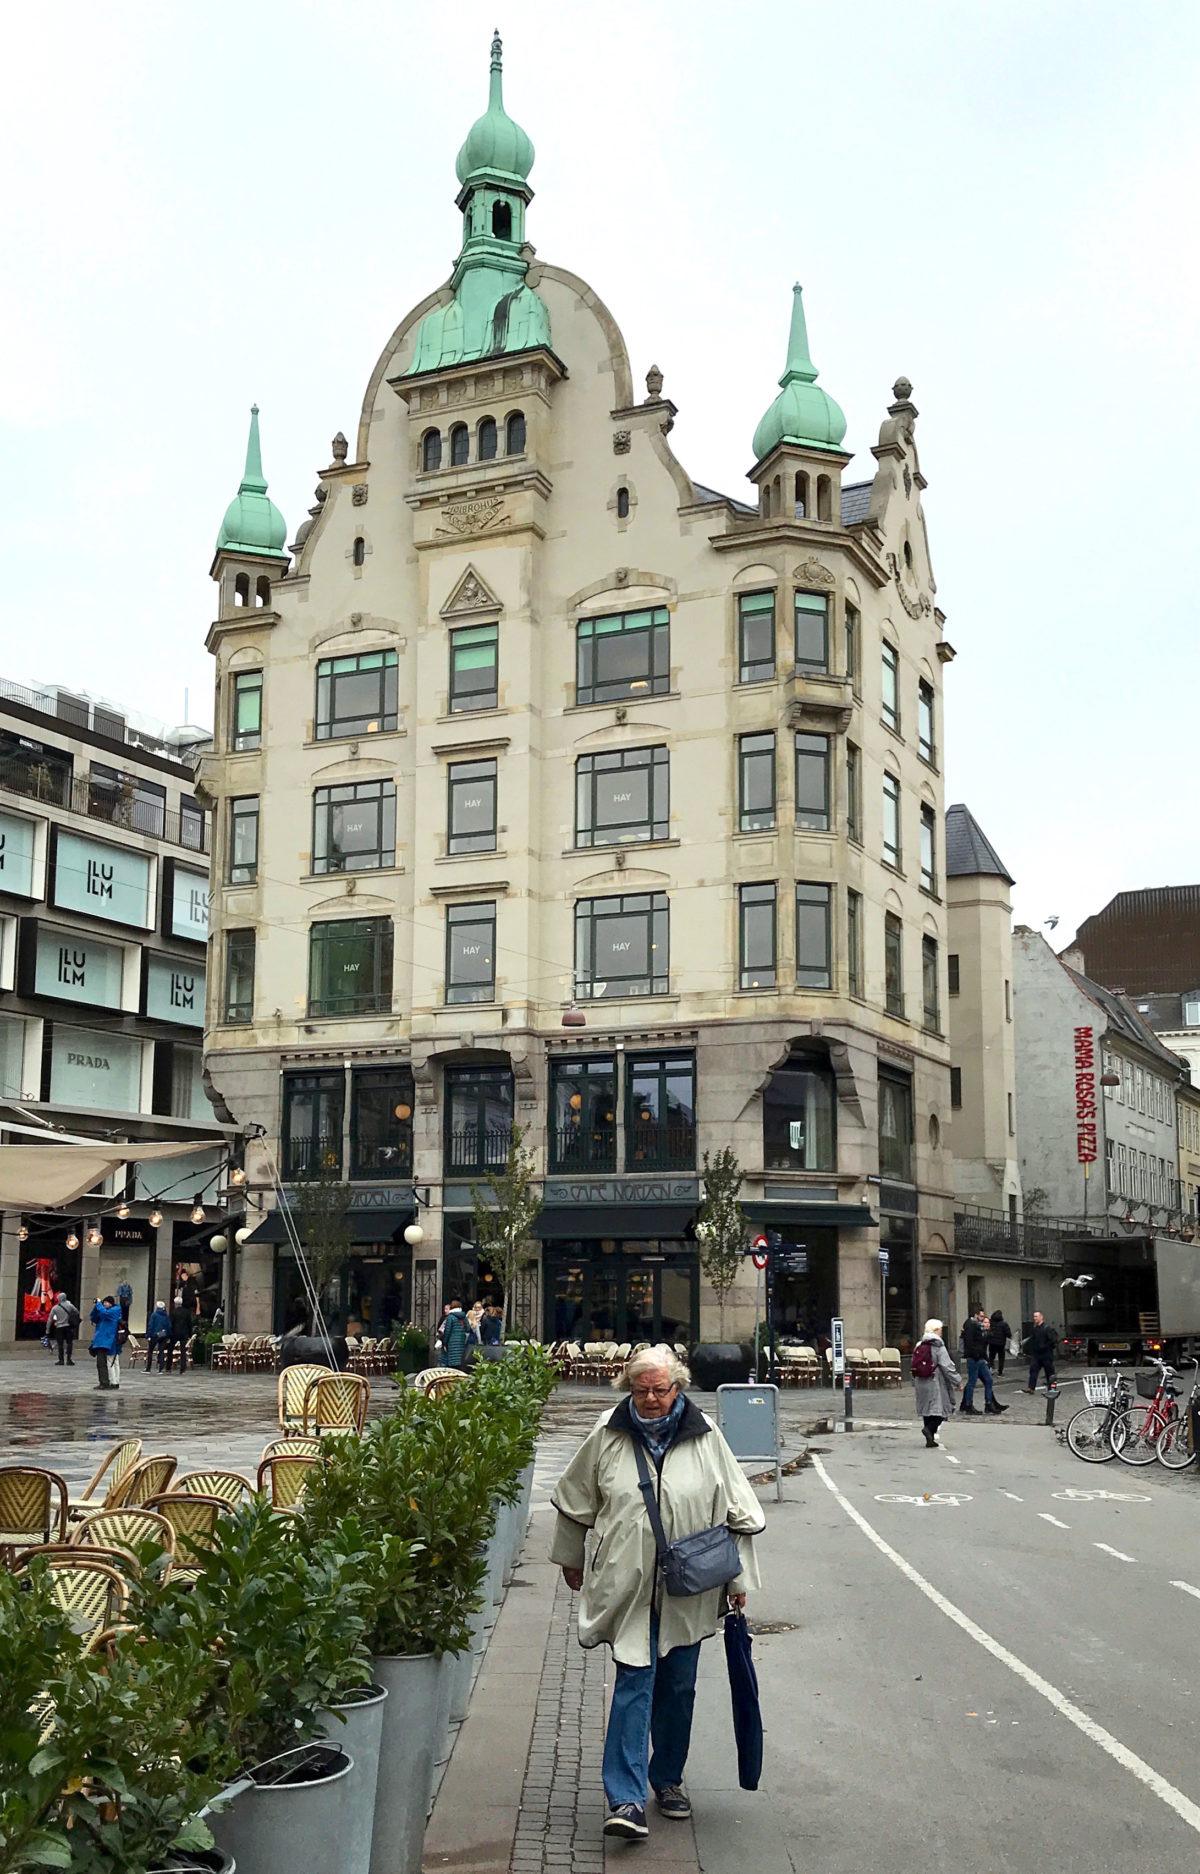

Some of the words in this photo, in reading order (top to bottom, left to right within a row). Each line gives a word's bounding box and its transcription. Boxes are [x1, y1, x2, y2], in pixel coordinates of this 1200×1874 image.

[613, 792, 632, 802] HAY
[464, 798, 482, 808] HAY
[346, 823, 363, 832] HAY
[463, 944, 481, 955] HAY
[612, 942, 631, 951] HAY
[343, 963, 360, 972] HAY
[1073, 1026, 1094, 1070] MAMA
[67, 1052, 110, 1071] PRADA
[1075, 1072, 1098, 1120] ROSA'S
[1077, 1123, 1097, 1164] PIZZA
